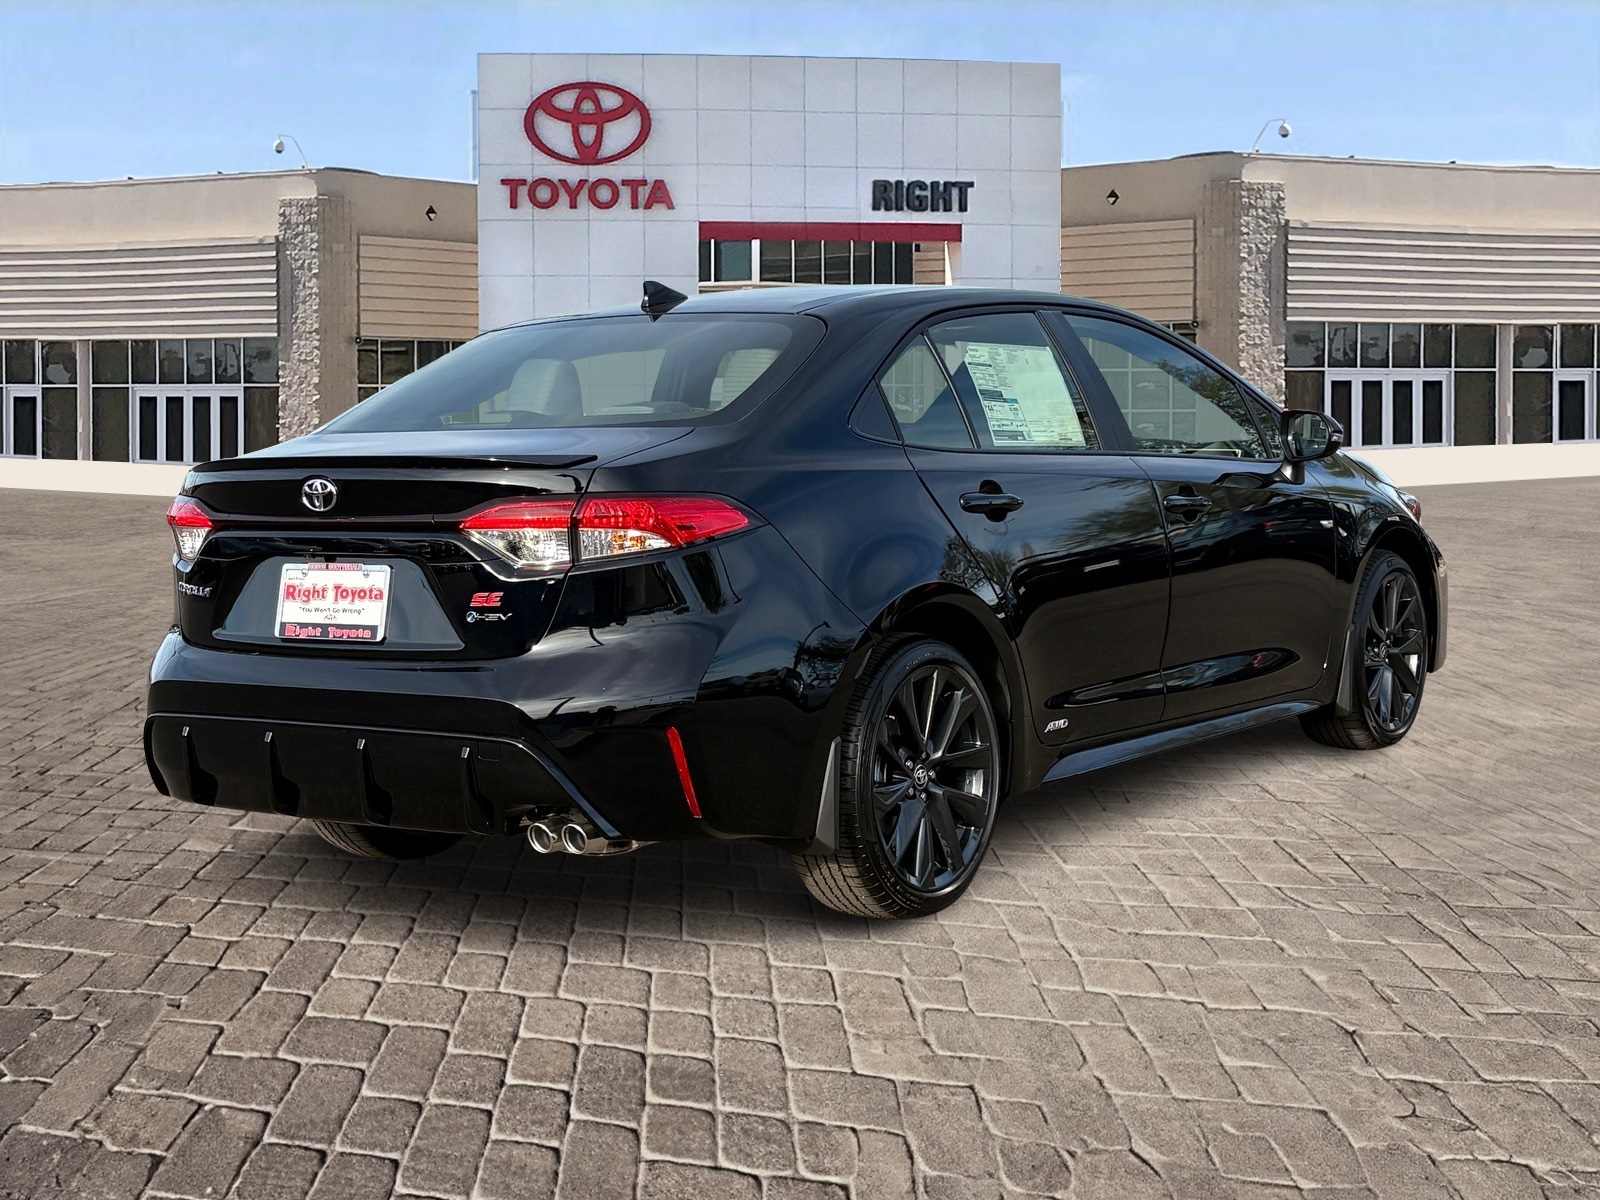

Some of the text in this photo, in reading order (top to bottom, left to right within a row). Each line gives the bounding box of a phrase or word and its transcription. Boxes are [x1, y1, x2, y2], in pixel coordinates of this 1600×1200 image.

[500, 178, 675, 210] TOYOTA
[872, 180, 975, 212] RIGHT
[284, 583, 384, 605] Right Toyota
[470, 591, 504, 607] SE
[285, 624, 372, 639] Right Toyota
